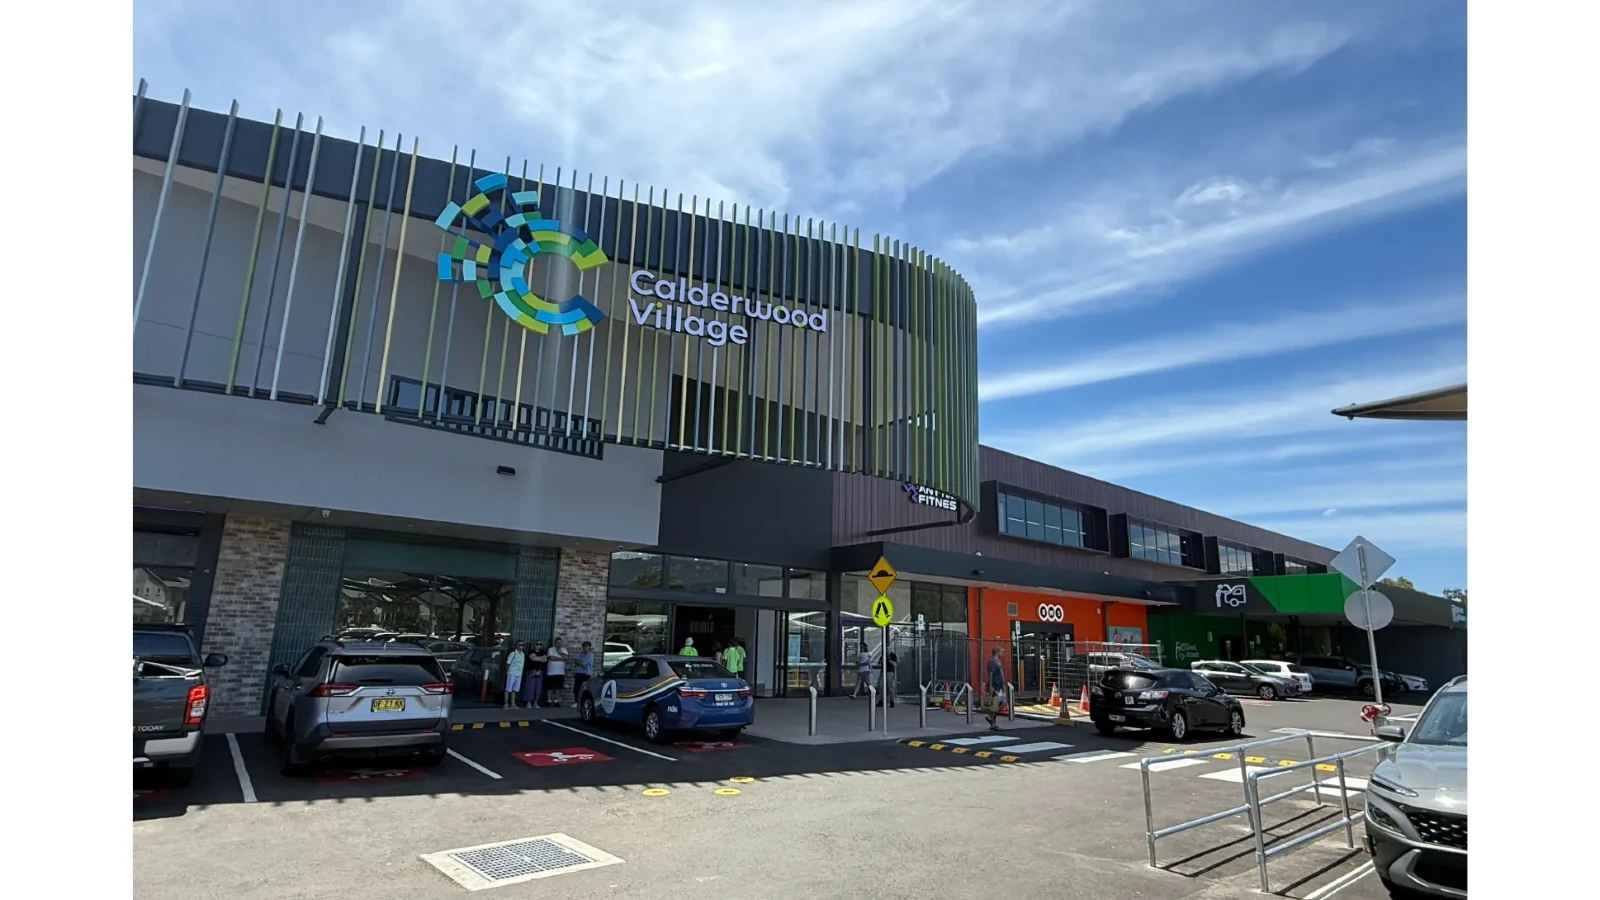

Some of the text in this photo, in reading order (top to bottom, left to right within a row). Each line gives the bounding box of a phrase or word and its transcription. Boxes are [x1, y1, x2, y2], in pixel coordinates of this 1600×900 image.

[628, 298, 748, 347] Village
[629, 269, 827, 332] Calderwood
[137, 724, 165, 732] TODAY
